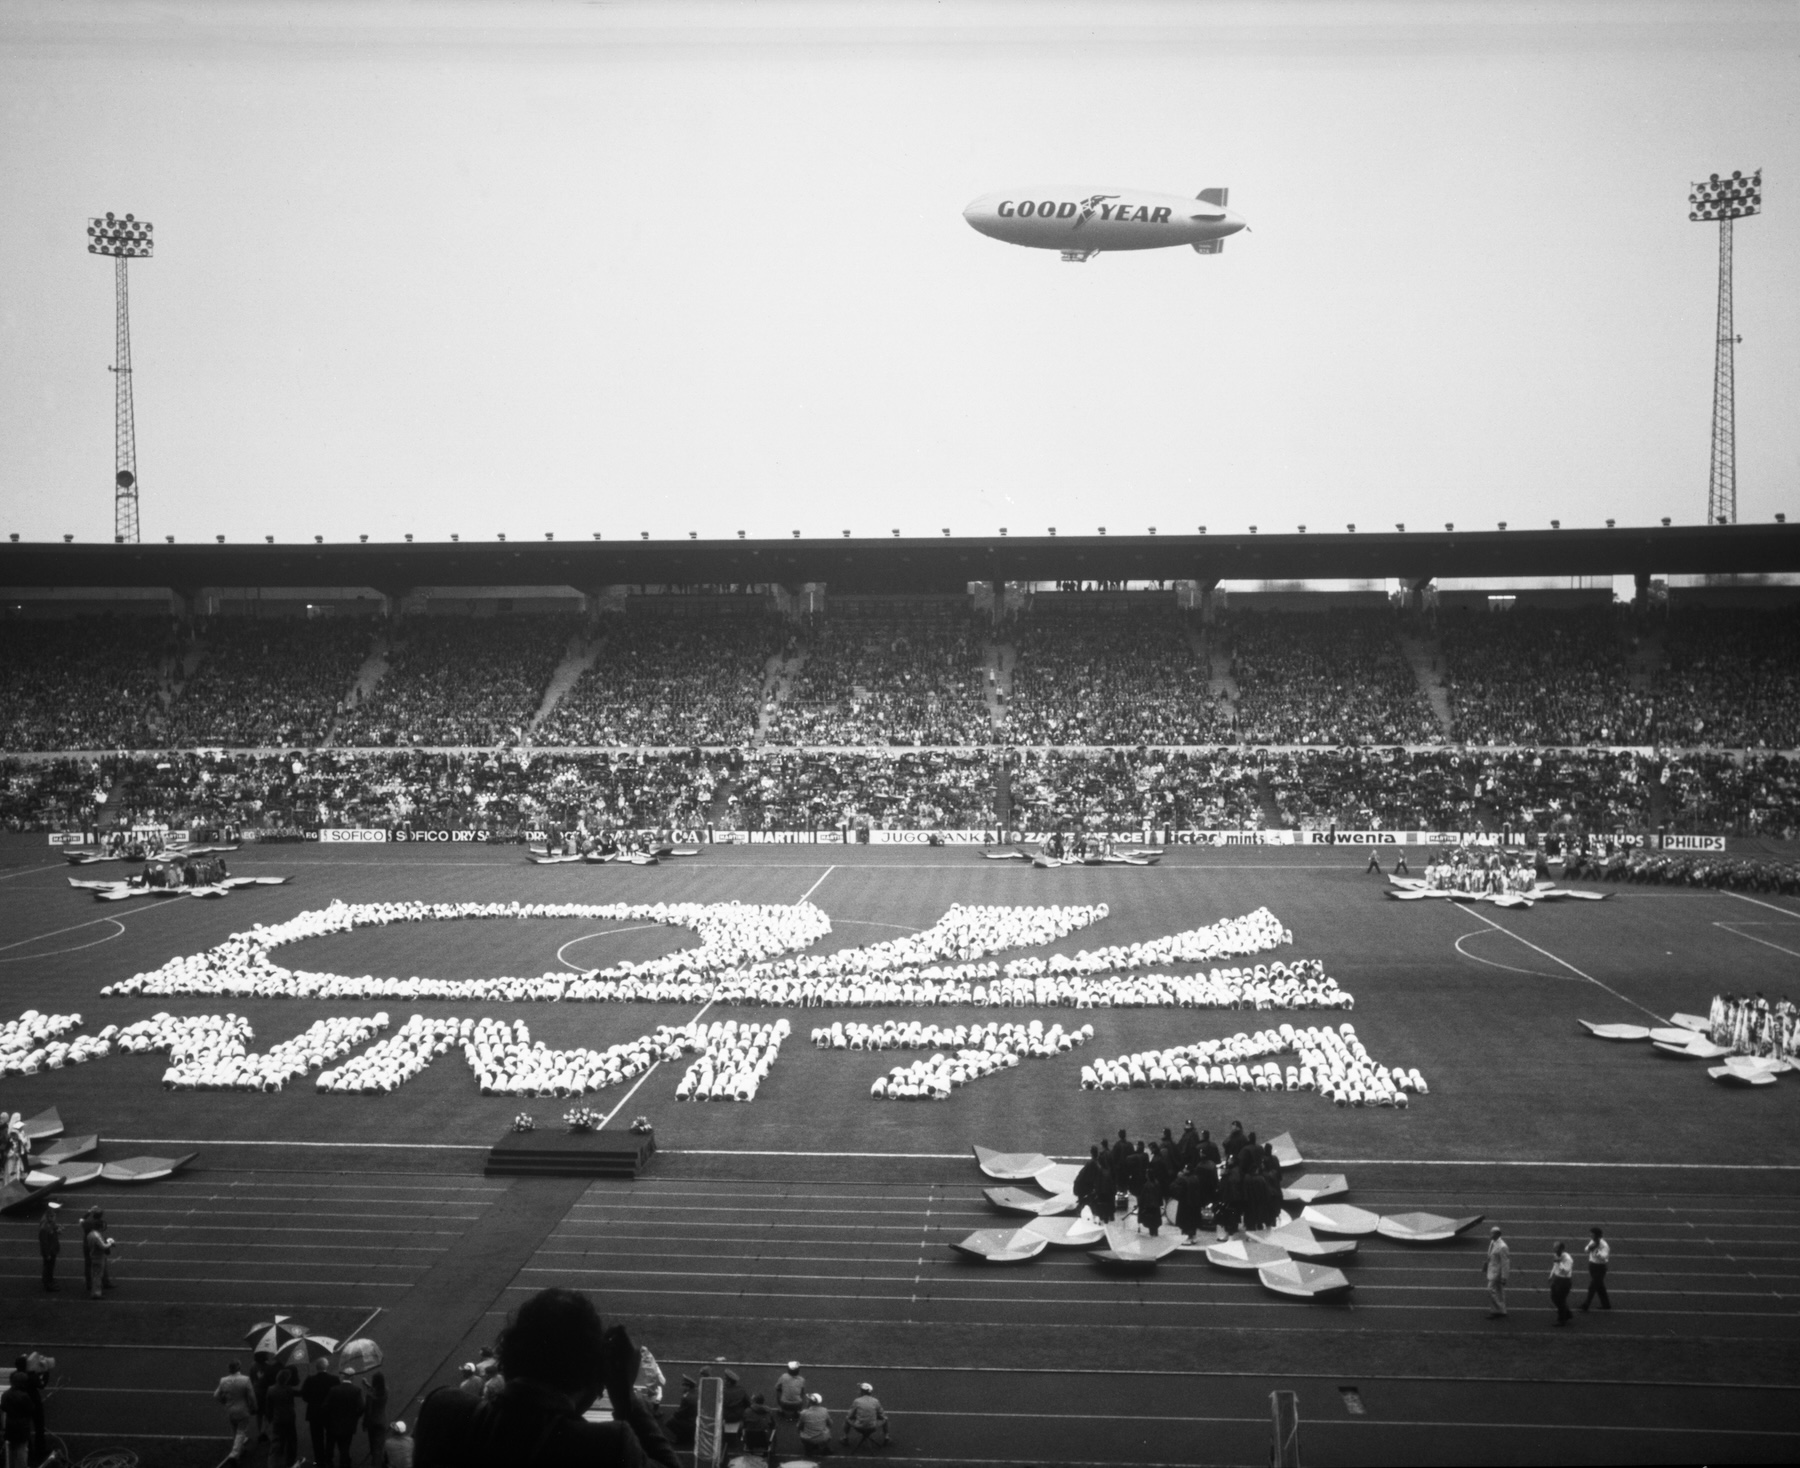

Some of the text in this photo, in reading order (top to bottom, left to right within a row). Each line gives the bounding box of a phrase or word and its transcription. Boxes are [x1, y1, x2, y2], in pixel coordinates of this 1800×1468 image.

[997, 200, 1172, 224] GOOD YEAR
[332, 830, 384, 842] SOFICO
[452, 830, 476, 842] DRY
[671, 830, 700, 843] C&A
[751, 831, 815, 843] MARTINI
[881, 832, 996, 843] JUGOANKA
[1226, 831, 1265, 845] mints
[1312, 832, 1397, 844] Rowenta
[1463, 832, 1526, 846] MARTIN
[1664, 837, 1723, 850] PHILIPS
